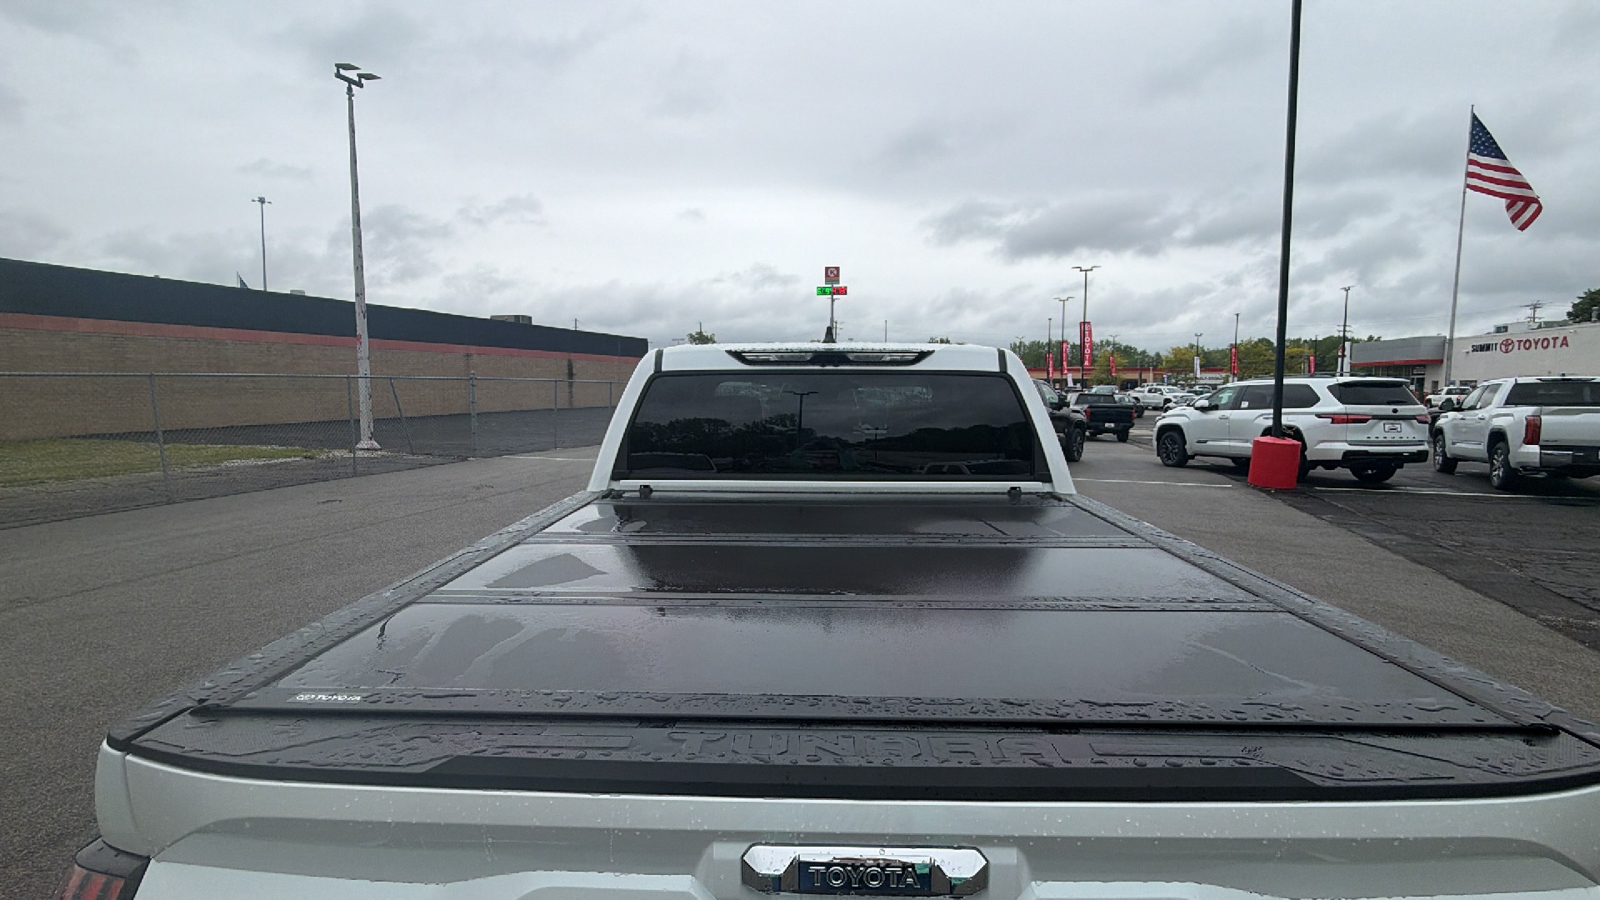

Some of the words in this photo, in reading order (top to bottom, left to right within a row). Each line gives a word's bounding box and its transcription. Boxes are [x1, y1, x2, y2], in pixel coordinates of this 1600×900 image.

[1471, 342, 1499, 353] SUMMIT
[1516, 336, 1569, 351] TOYOTA
[667, 731, 1070, 762] TUNDRA
[807, 865, 921, 888] TOYOTA
